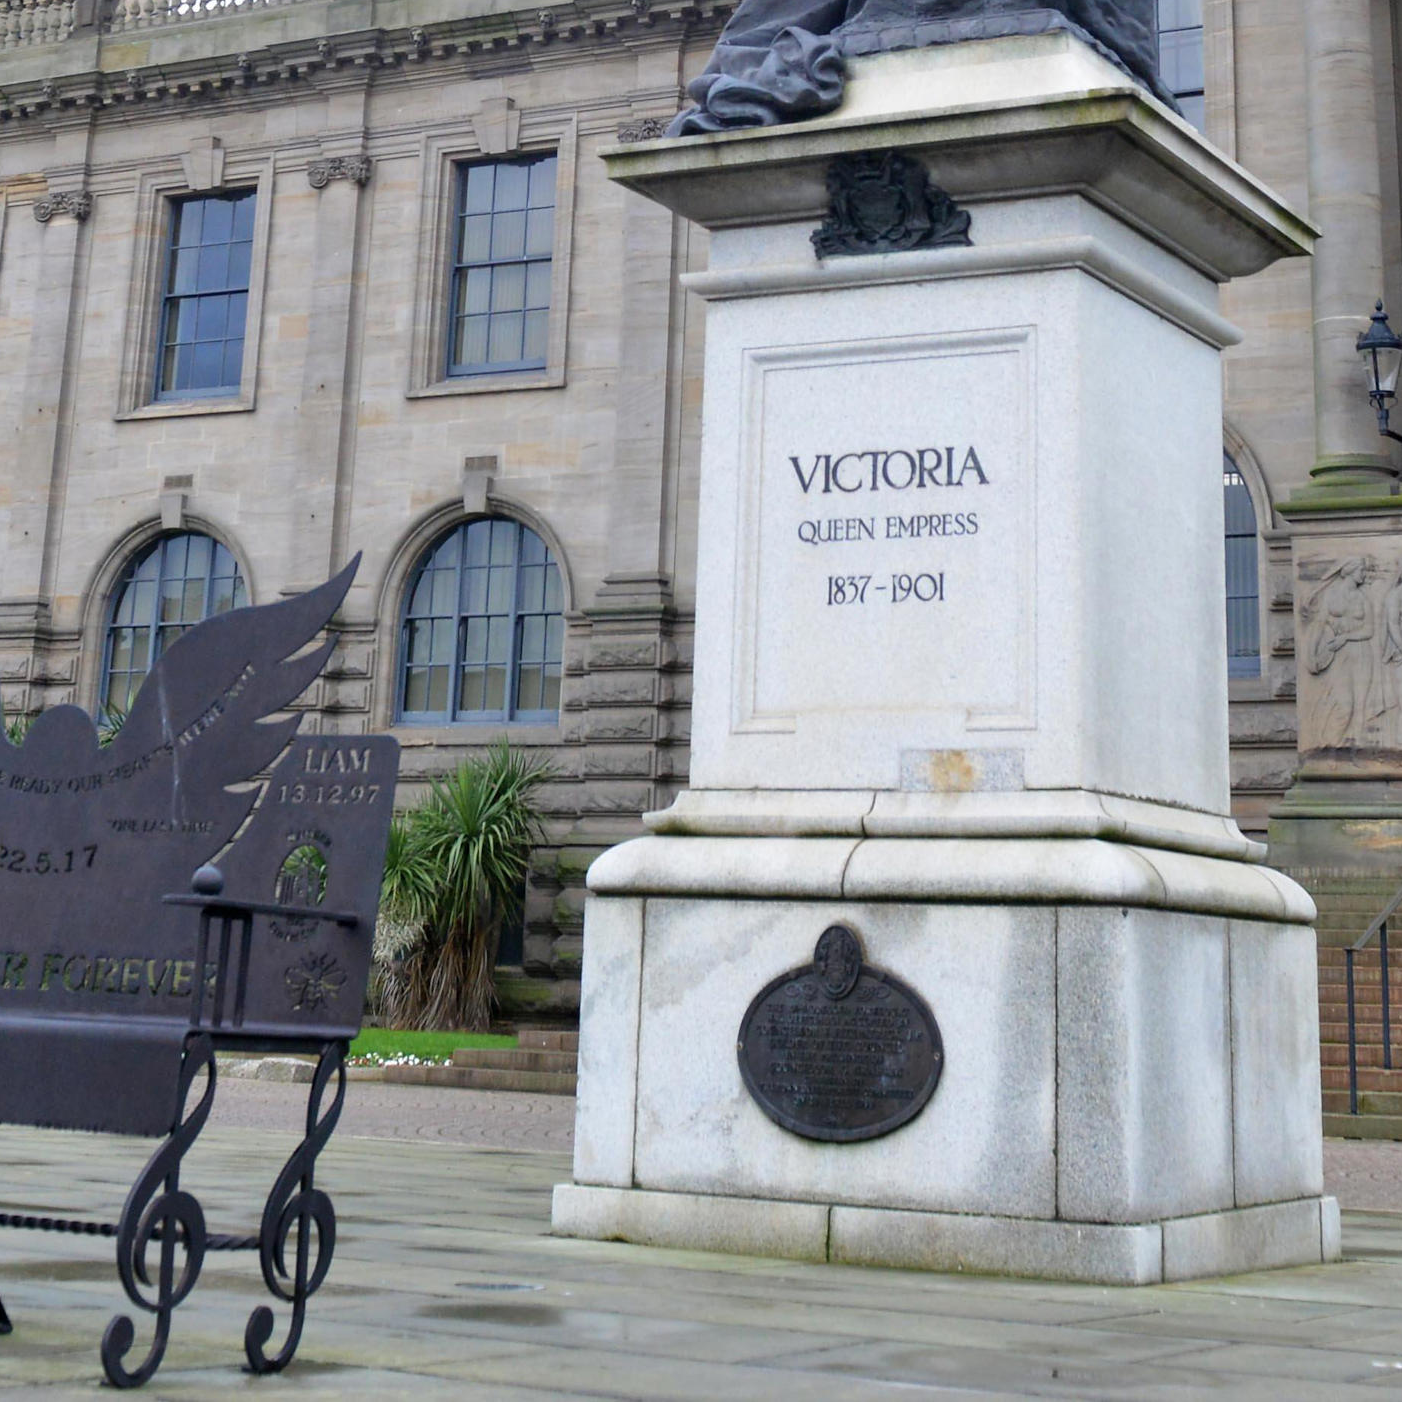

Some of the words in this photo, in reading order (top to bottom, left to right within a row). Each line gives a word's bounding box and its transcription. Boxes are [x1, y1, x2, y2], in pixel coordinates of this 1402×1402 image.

[789, 445, 990, 494] VICTORIA
[798, 518, 875, 545] QUEEN
[885, 513, 979, 540] EMPRESS
[304, 747, 372, 775] LIAM
[9, 774, 62, 795] READY
[67, 772, 103, 794] OUR
[278, 784, 381, 806] 13.12.97
